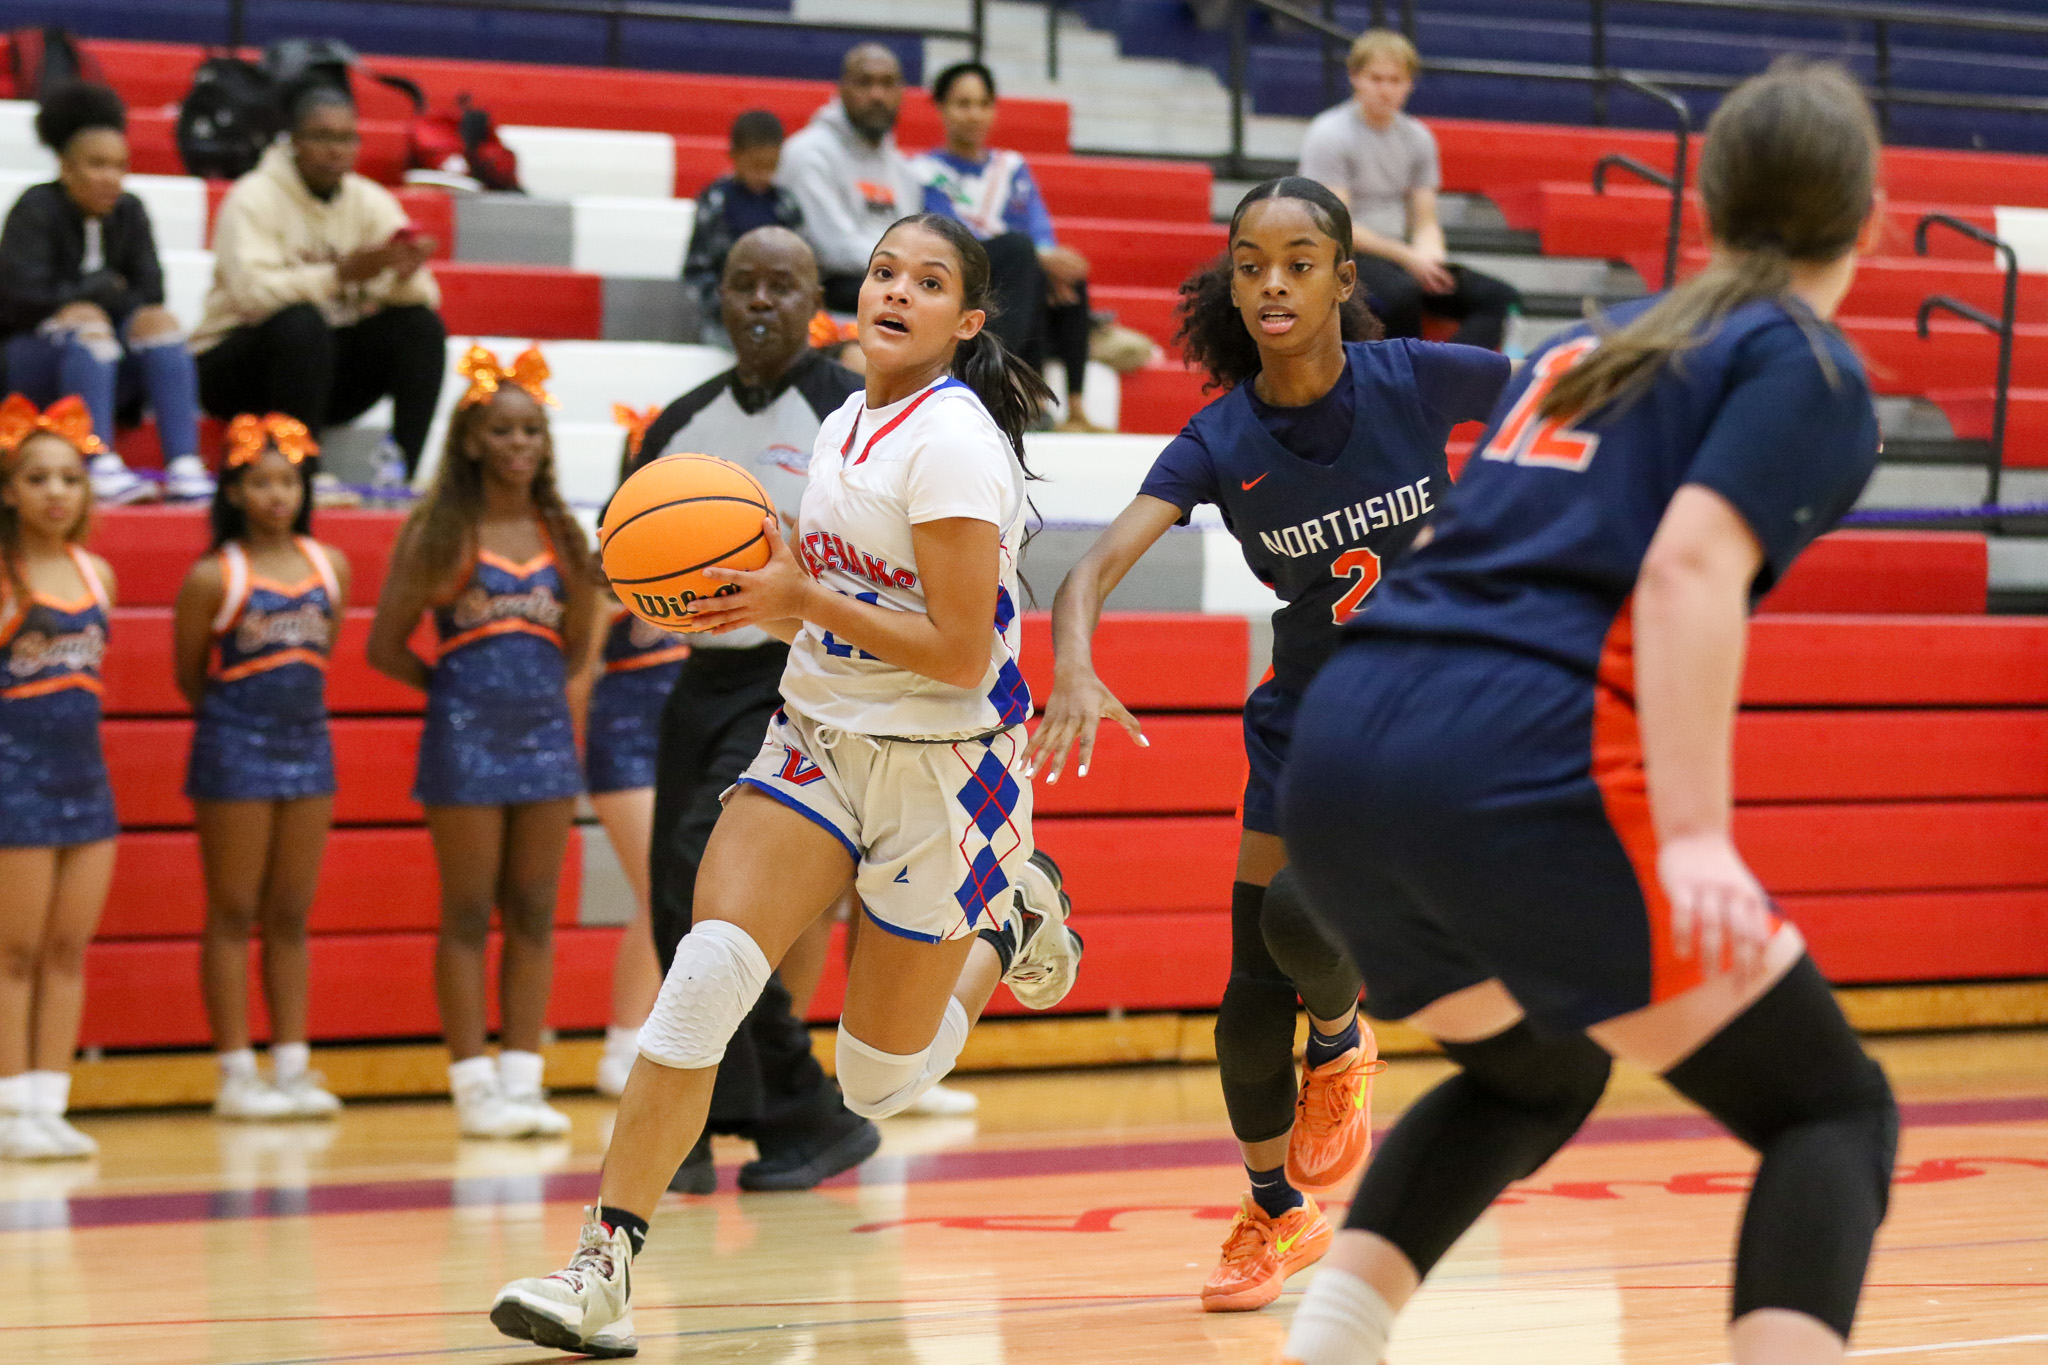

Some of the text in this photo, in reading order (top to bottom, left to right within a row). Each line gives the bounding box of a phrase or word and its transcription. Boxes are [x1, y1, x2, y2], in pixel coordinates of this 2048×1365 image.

[1259, 476, 1435, 558] NORTHSIDE
[800, 531, 917, 589] ETERANS
[1330, 547, 1382, 625] 2
[771, 744, 826, 787] V
